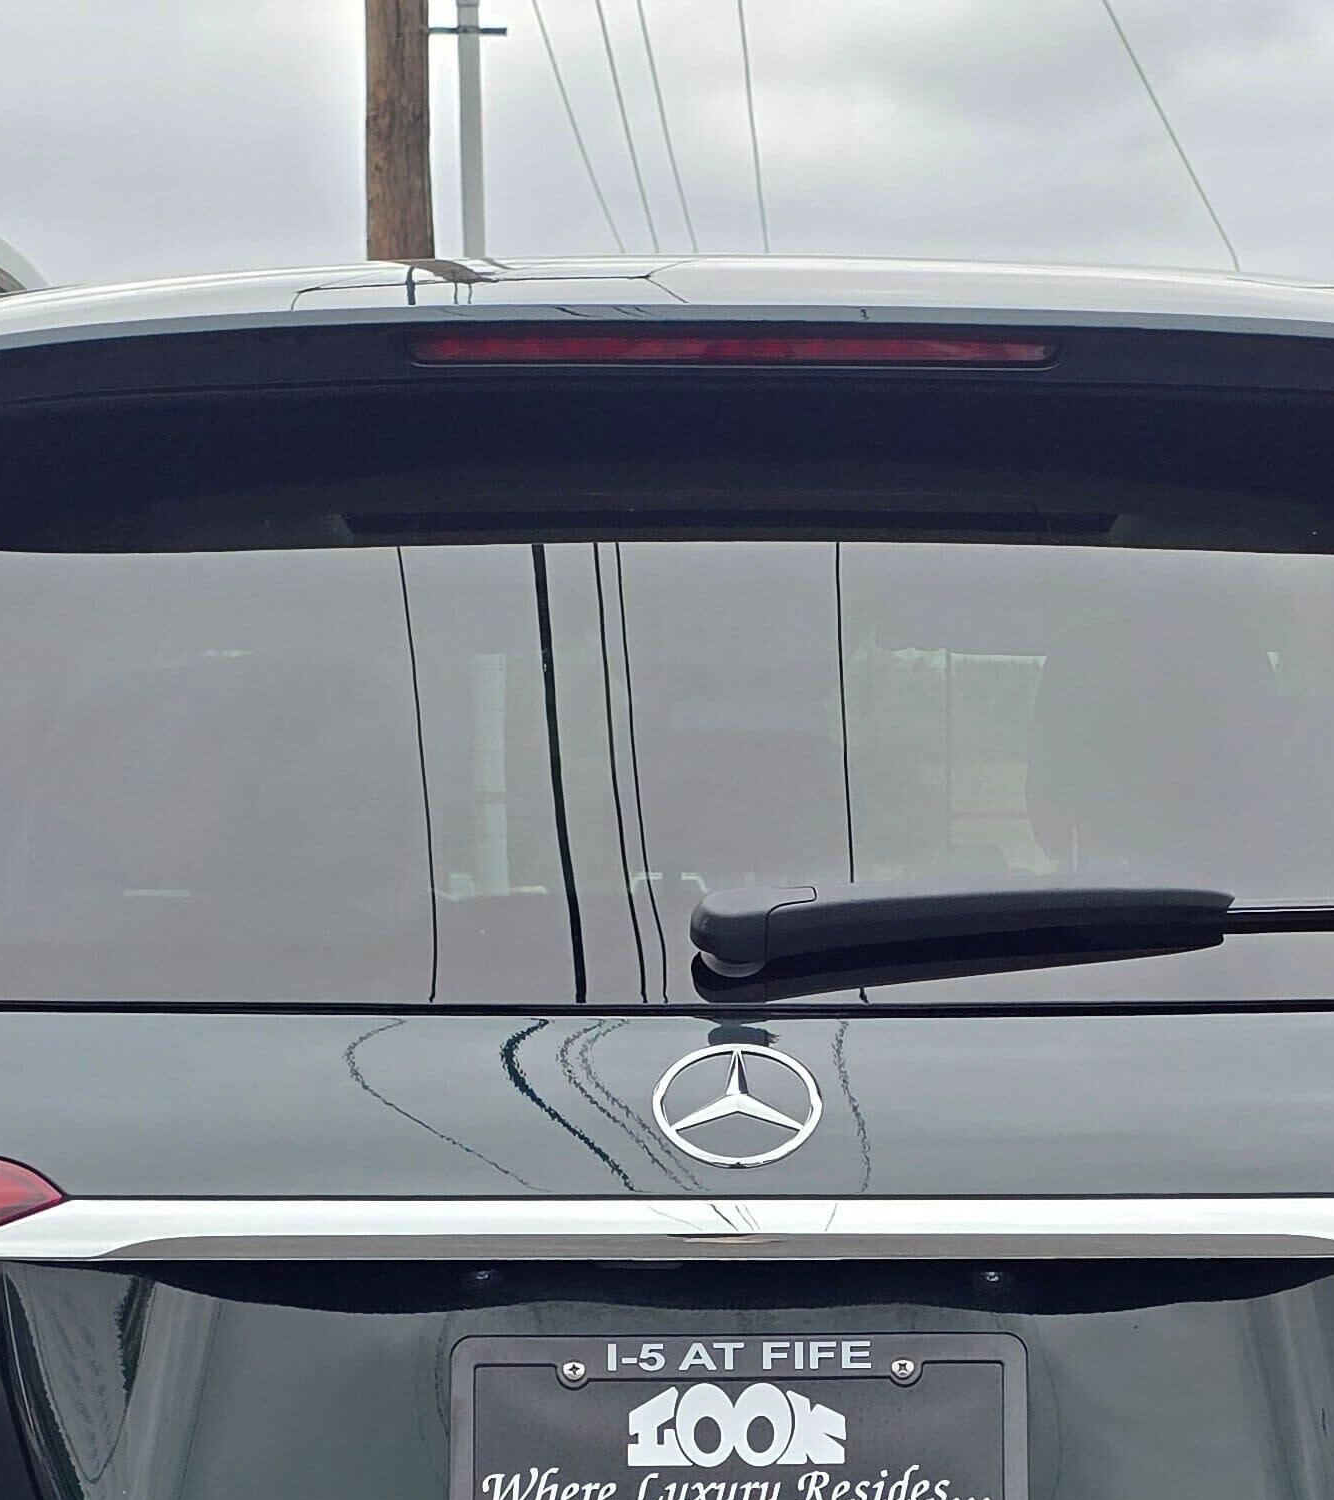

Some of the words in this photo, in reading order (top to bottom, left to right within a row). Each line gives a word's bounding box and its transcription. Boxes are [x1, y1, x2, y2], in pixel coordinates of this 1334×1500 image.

[606, 1342, 666, 1372] I-5
[679, 1341, 745, 1371] AT
[762, 1340, 873, 1370] FIFE
